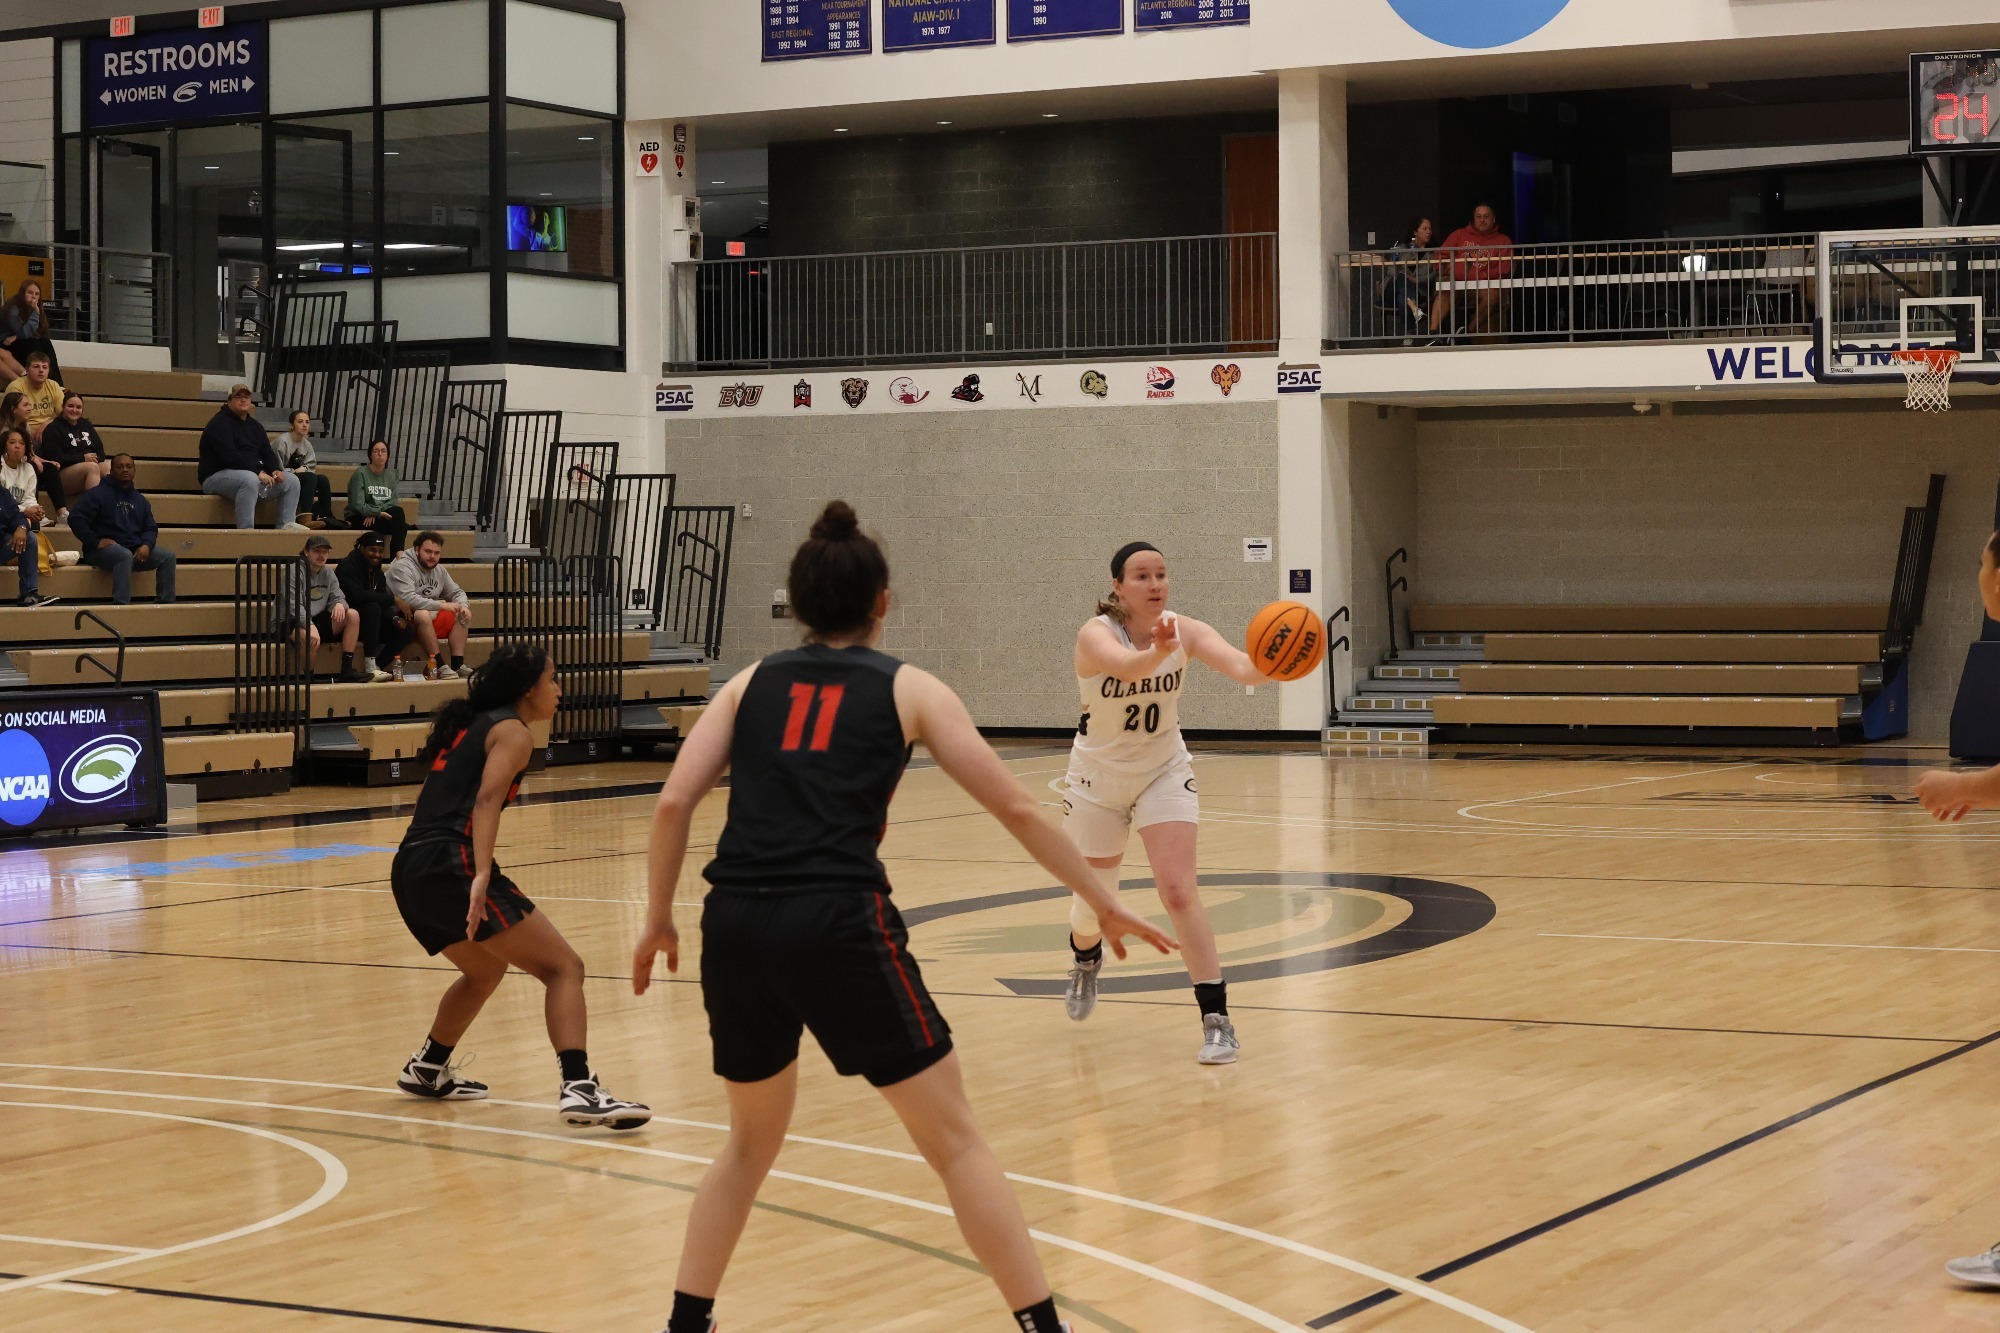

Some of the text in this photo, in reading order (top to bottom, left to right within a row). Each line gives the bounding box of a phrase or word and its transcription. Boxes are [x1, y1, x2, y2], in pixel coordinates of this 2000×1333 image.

[1140, 0, 1196, 10] ATLANTIC REGIONAL
[1198, 0, 1214, 8] 2006
[202, 8, 221, 26] EXIT
[827, 11, 861, 20] APPEARANCES
[913, 9, 955, 23] AIAW-DIV.
[1198, 10, 1214, 19] 2007
[114, 17, 132, 35] EXIT
[771, 28, 814, 39] EAST REGIONAL
[845, 40, 860, 48] 2005
[104, 39, 250, 78] RESTROOMS
[114, 78, 239, 104] WOMEN MEN
[1934, 93, 1988, 140] 24
[639, 141, 660, 152] AED
[674, 143, 686, 153] AED
[1278, 370, 1322, 386] PSAC
[656, 390, 694, 405] PSAC
[1147, 390, 1175, 399] RAIDERS
[1264, 624, 1292, 662] NCAA
[1101, 668, 1183, 698] CLARION
[4, 712, 23, 728] ON
[25, 710, 67, 727] SOCIAL
[70, 708, 106, 725] MEDIA
[780, 682, 845, 752] 11
[1124, 703, 1160, 734] 20
[0, 774, 50, 802] NCAA
